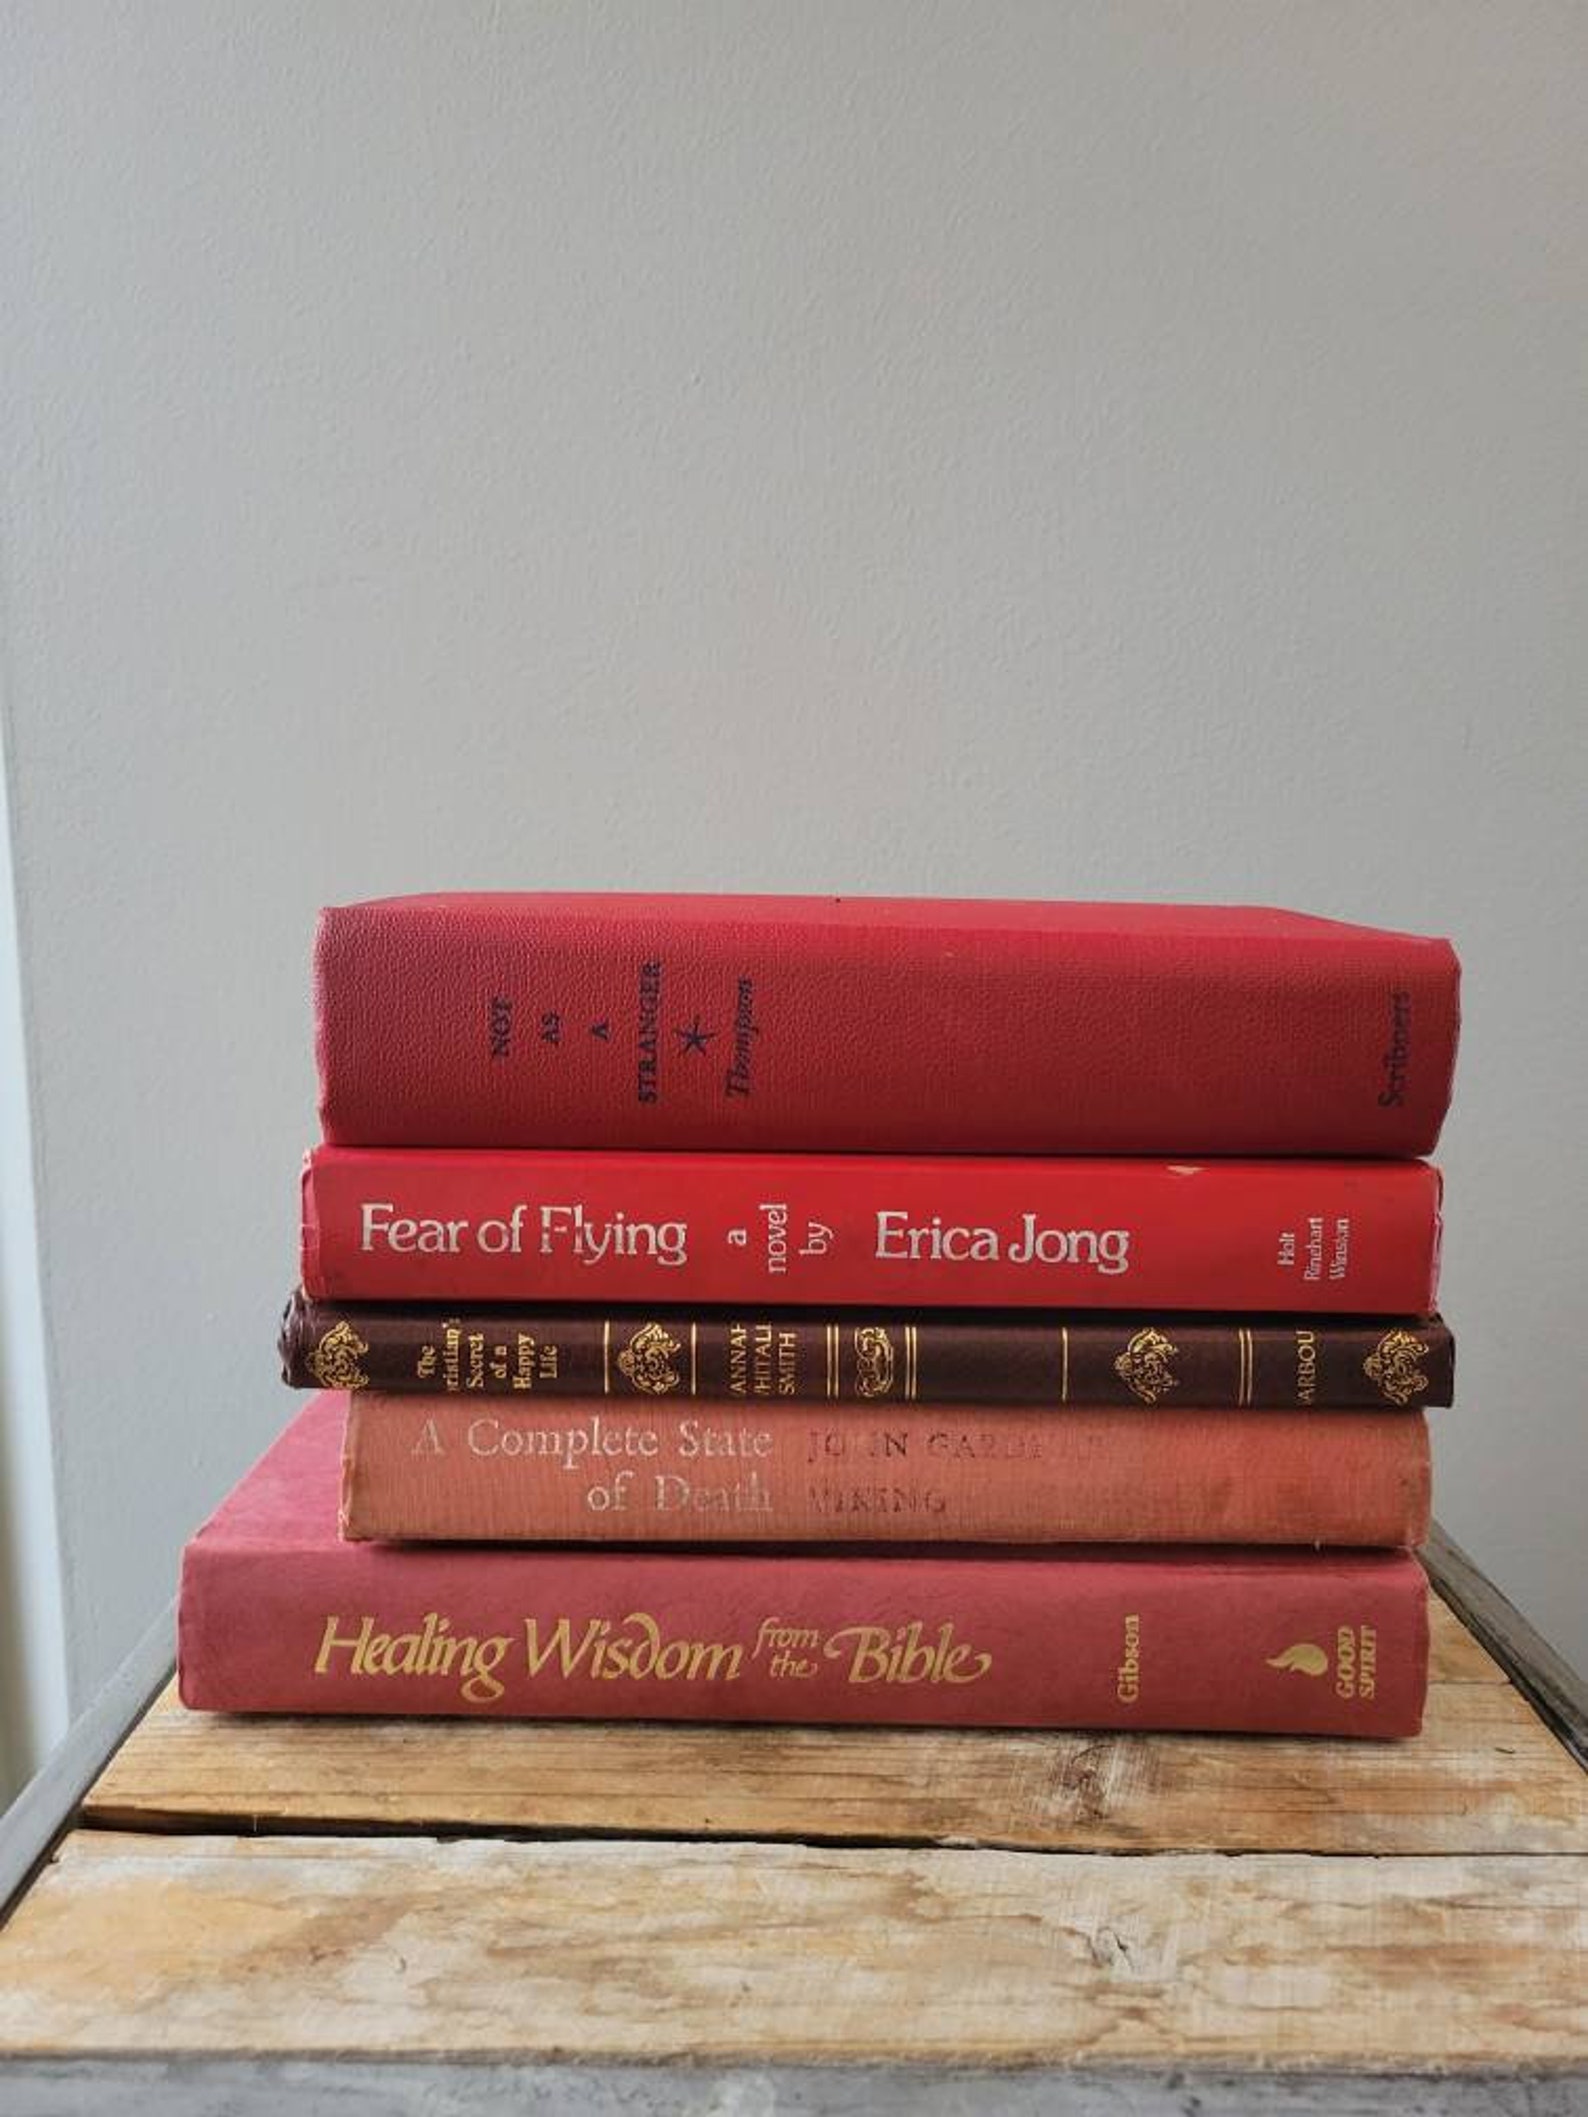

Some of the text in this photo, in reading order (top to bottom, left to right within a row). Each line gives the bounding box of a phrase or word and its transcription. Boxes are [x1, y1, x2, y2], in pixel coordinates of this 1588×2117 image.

[490, 997, 512, 1059] NOT
[541, 1010, 561, 1045] AS
[590, 1021, 610, 1041] A
[638, 961, 662, 1102] STRANGER
[361, 1203, 688, 1266] Fear of Flying
[727, 1229, 747, 1246] a
[759, 1203, 788, 1274] novel
[800, 1221, 835, 1256] by
[874, 1211, 1131, 1275] Erica Jong
[1277, 1232, 1296, 1266] Holt
[1304, 1217, 1324, 1281] Rinehart
[1329, 1218, 1350, 1280] Winston
[416, 1344, 437, 1378] The
[466, 1332, 485, 1388] Secret
[490, 1345, 508, 1379] of a
[513, 1332, 535, 1389] Happy
[539, 1345, 558, 1379] Life
[778, 1332, 797, 1396] SMITH
[411, 1416, 773, 1470] A Complete State
[807, 1432, 908, 1463] JON
[587, 1471, 773, 1513] of Death
[314, 1612, 819, 1702] Healing Wisdom from
[770, 1650, 818, 1678] the
[823, 1620, 992, 1684] Bible
[1117, 1614, 1140, 1702] Gibson
[1336, 1625, 1356, 1699] GOOD
[1358, 1625, 1378, 1699] SPIRIT
